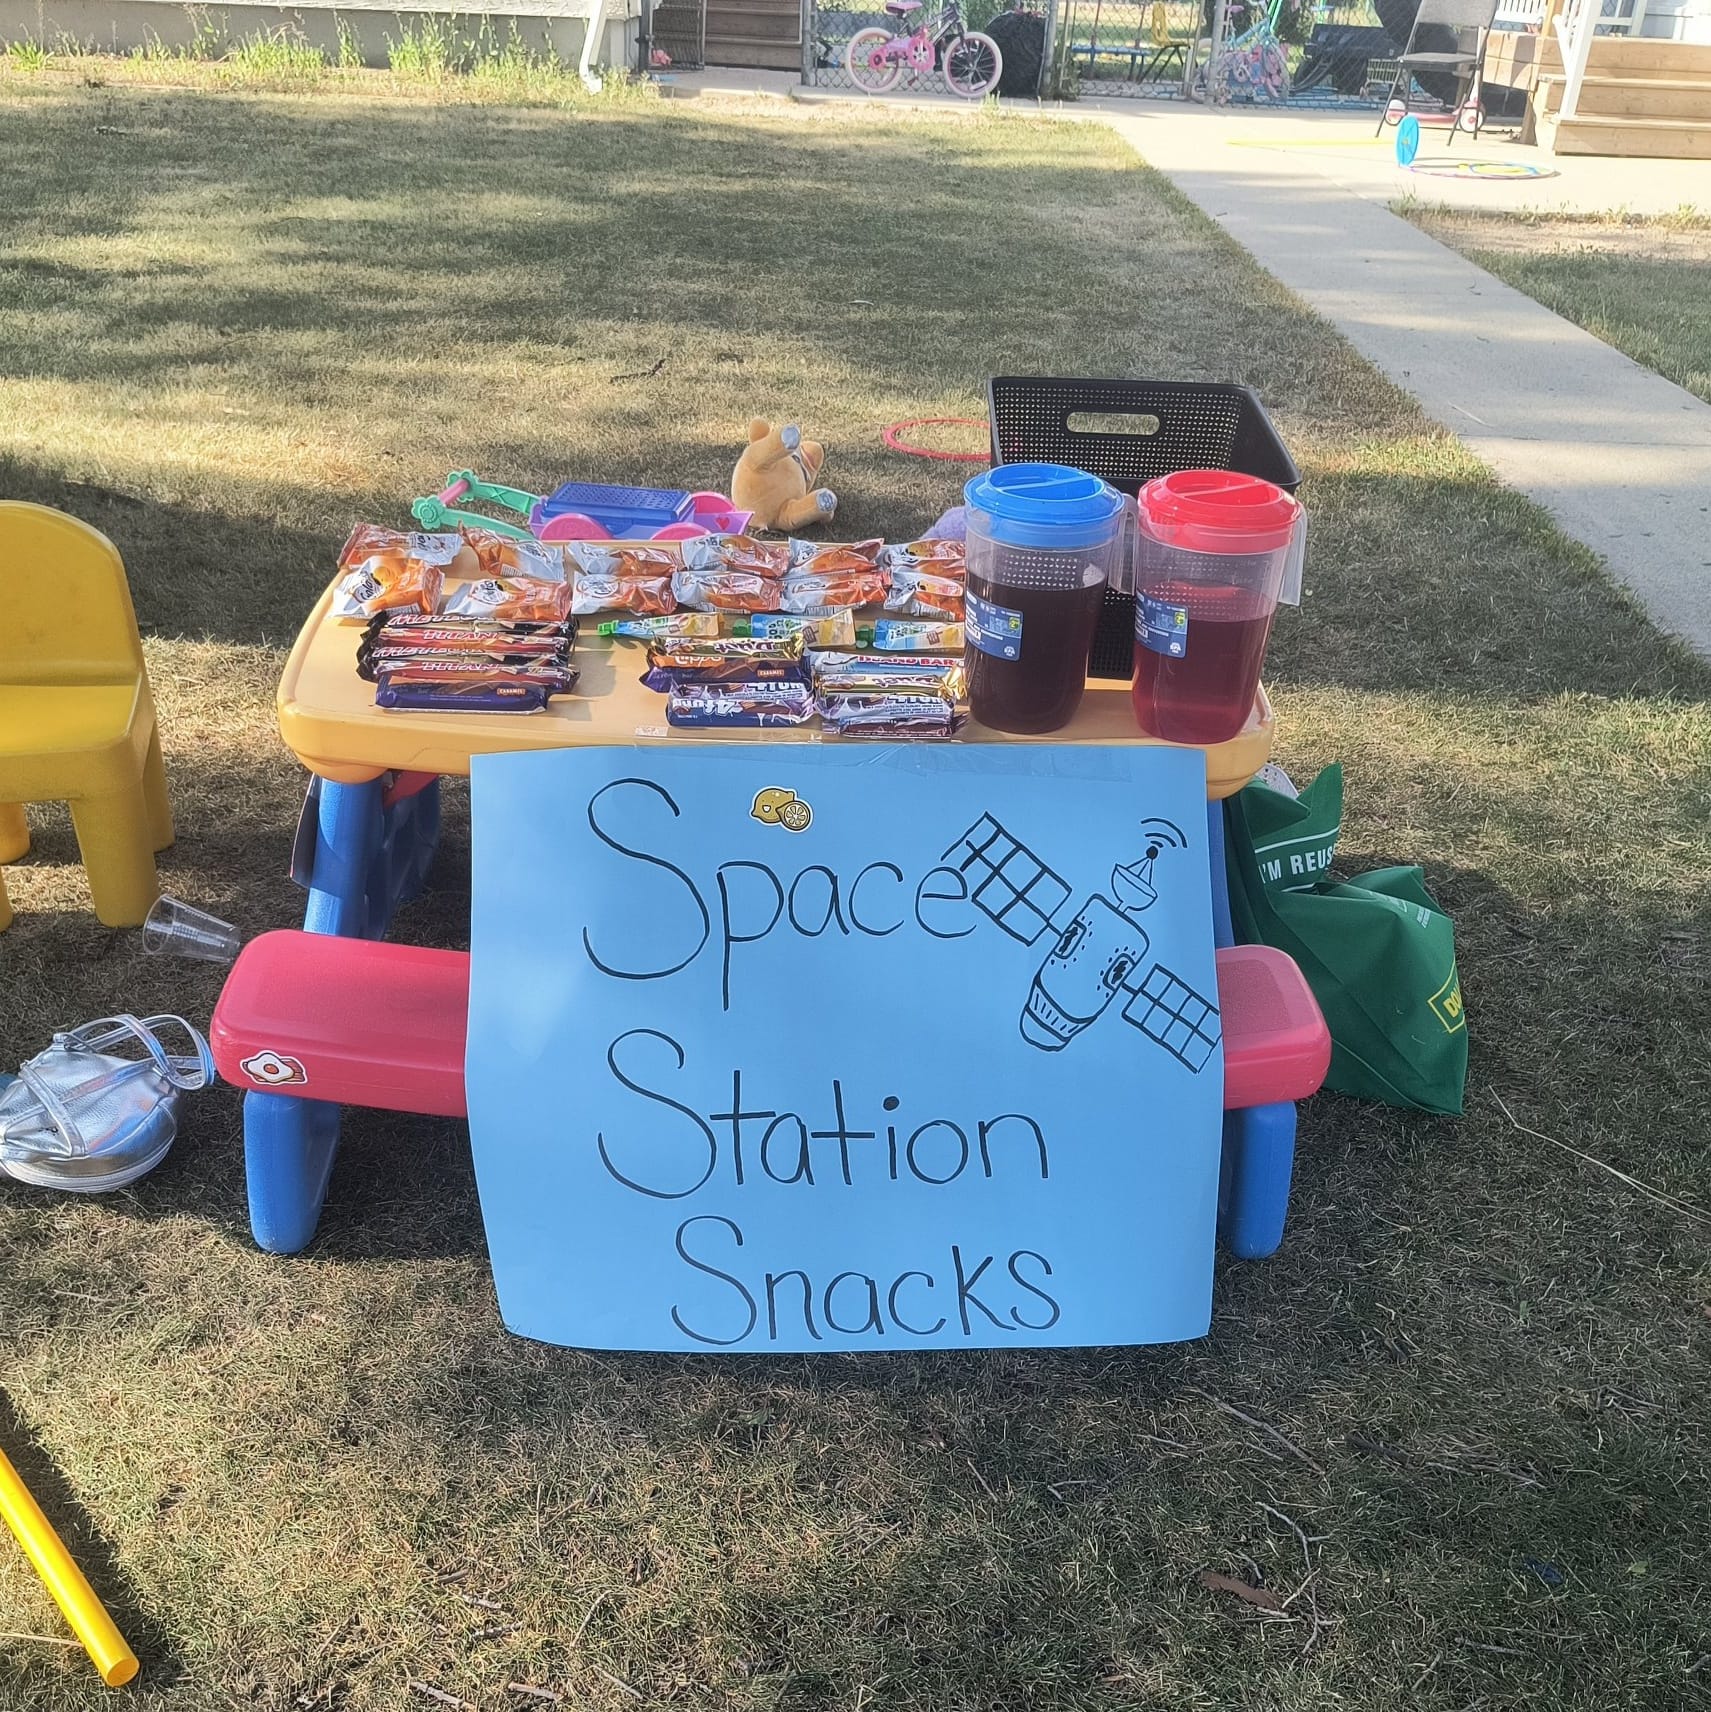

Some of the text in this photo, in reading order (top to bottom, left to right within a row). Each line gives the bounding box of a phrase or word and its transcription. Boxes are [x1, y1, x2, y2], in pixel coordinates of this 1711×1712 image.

[919, 657, 955, 666] BAR
[583, 777, 977, 1010] Space
[1258, 845, 1335, 884] I'M REUS
[598, 1028, 1049, 1199] Station
[671, 1214, 1061, 1345] Snacks
